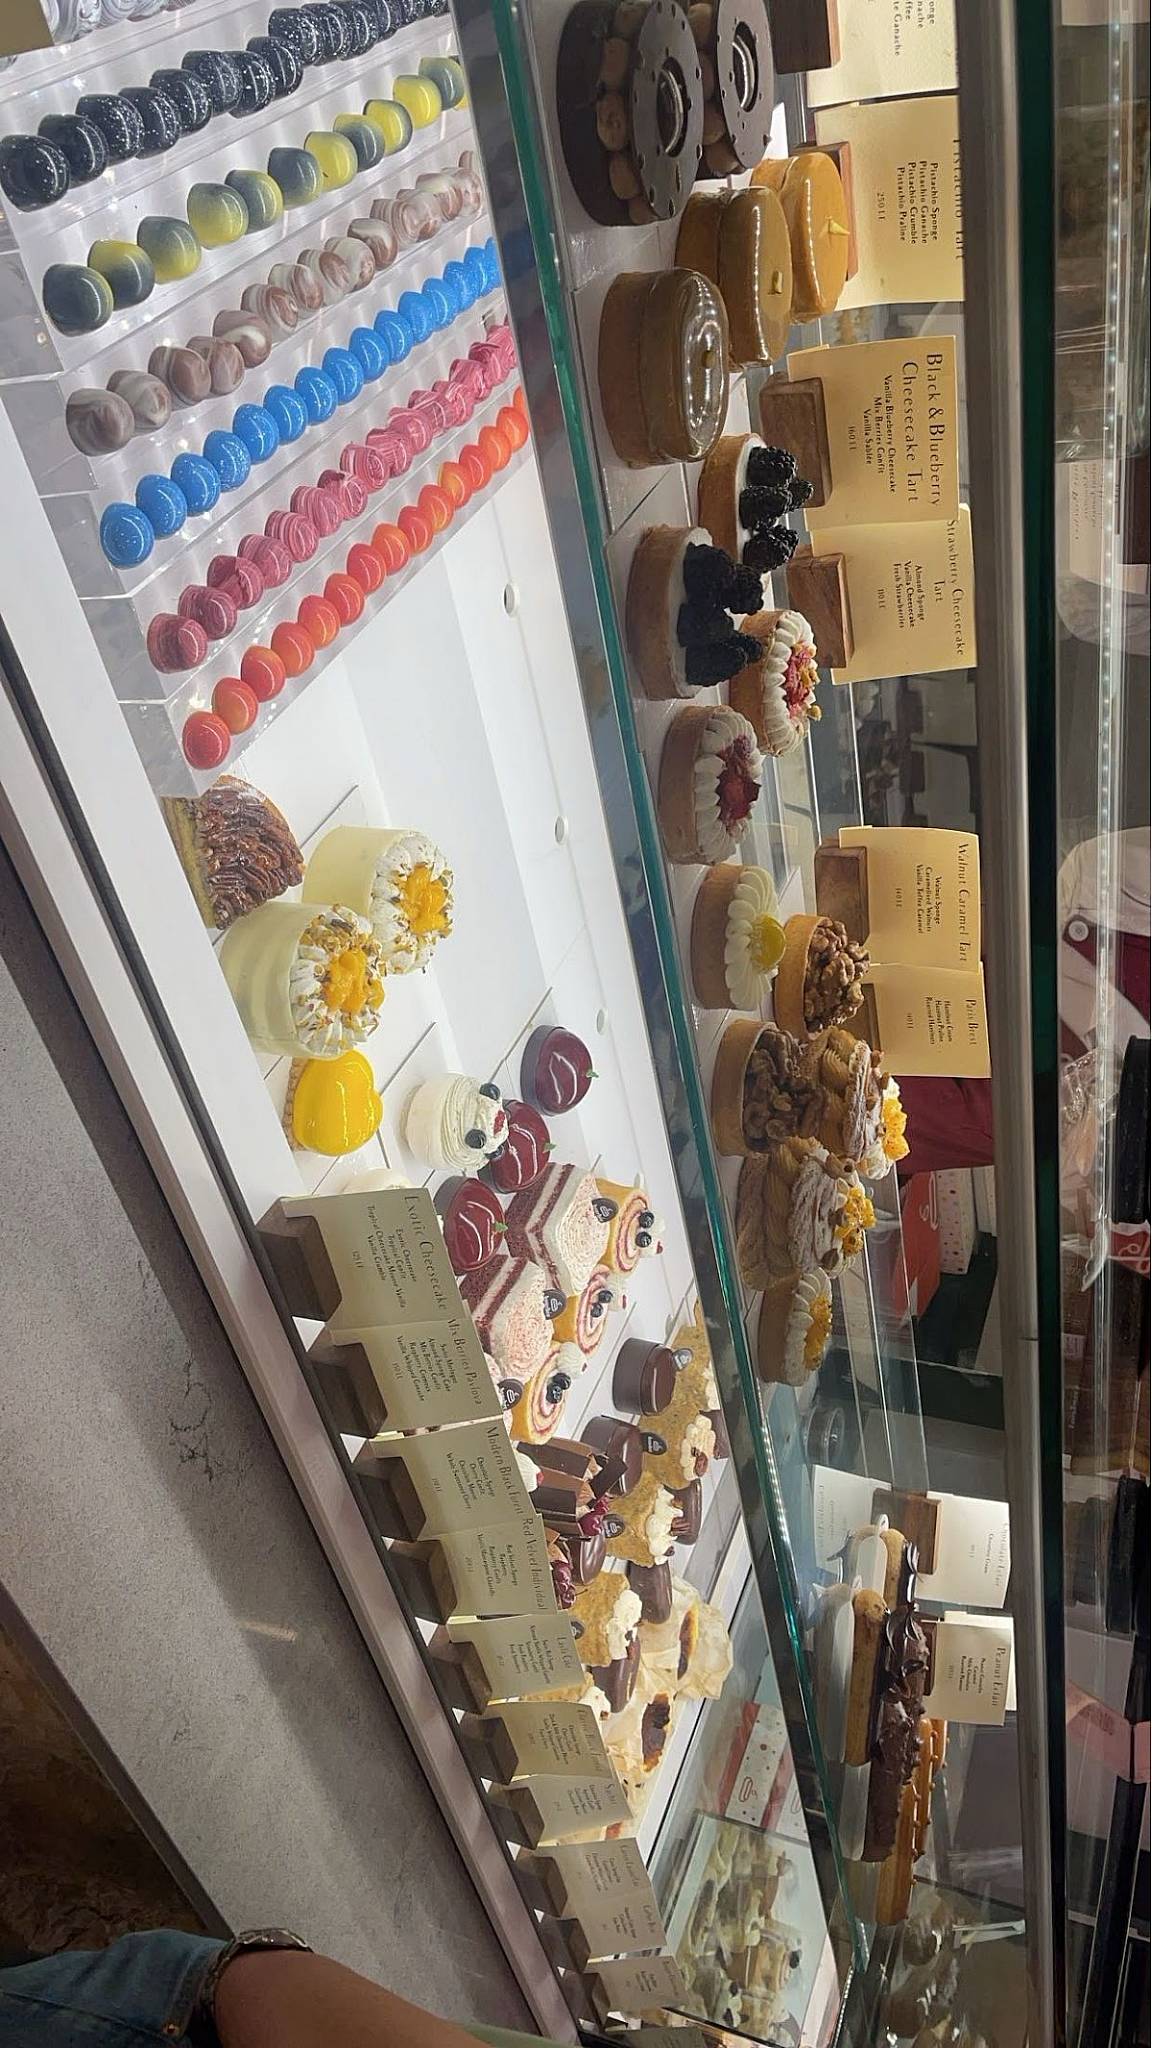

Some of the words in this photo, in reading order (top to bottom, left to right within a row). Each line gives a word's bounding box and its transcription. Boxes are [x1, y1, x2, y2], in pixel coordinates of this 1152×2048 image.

[894, 14, 903, 56] Ganache
[897, 167, 906, 209] Pistachio
[908, 162, 917, 204] Pistachio
[919, 160, 927, 202] Pistachio
[931, 163, 939, 205] Pistachio
[877, 192, 885, 208] 250
[899, 211, 907, 241] Praline
[910, 207, 918, 244] Crumble
[920, 206, 929, 244] Ganache
[930, 207, 940, 241] Sponge
[884, 375, 893, 403] Vanilla
[926, 354, 943, 401] Black
[873, 397, 882, 413] Mix
[902, 362, 919, 462] Cheesecake
[928, 408, 944, 419] &
[863, 408, 872, 436] Vanilla
[874, 416, 884, 445] Berries
[884, 406, 894, 445] Blueberry
[877, 447, 885, 474] Confit
[887, 448, 897, 493] Cheesecake
[927, 424, 946, 507] Blueberry
[907, 468, 924, 503] Tart
[946, 520, 959, 584] Strawberry
[893, 563, 901, 582] Fresh
[904, 561, 912, 585] Vanilla
[914, 565, 924, 593] Almond
[896, 584, 904, 628] Strawberries
[934, 580, 946, 602] Tart
[906, 588, 915, 628] Cheesecake
[917, 595, 925, 621] Sponge
[952, 588, 965, 655] Cheesecake
[958, 844, 969, 884] Walnut
[934, 901, 942, 924] Sponge
[959, 889, 970, 935] Caramel
[959, 942, 971, 962] Tart
[966, 1000, 977, 1020] Paris
[968, 1023, 979, 1046] Brest
[367, 1235, 377, 1255] Vanilla
[374, 1257, 386, 1281] Crumble
[375, 1231, 390, 1264] Cheesecake
[396, 1229, 404, 1248] Exotic
[403, 1249, 416, 1282] Cheesecake
[404, 1196, 425, 1237] Exotic
[419, 1241, 447, 1310] Cheesecake
[396, 1260, 406, 1279] Confit
[448, 1319, 460, 1336] Mix
[453, 1339, 469, 1370] Berries
[413, 1379, 424, 1401] Ganache
[443, 1379, 451, 1392] Cake
[466, 1372, 482, 1405] Pavlova
[486, 1427, 503, 1465] Modern
[499, 1467, 514, 1490] Black
[523, 1518, 534, 1536] Red
[526, 1540, 537, 1566] Velvet
[531, 1569, 548, 1609] Individual
[994, 1648, 1006, 1678] Peanut
